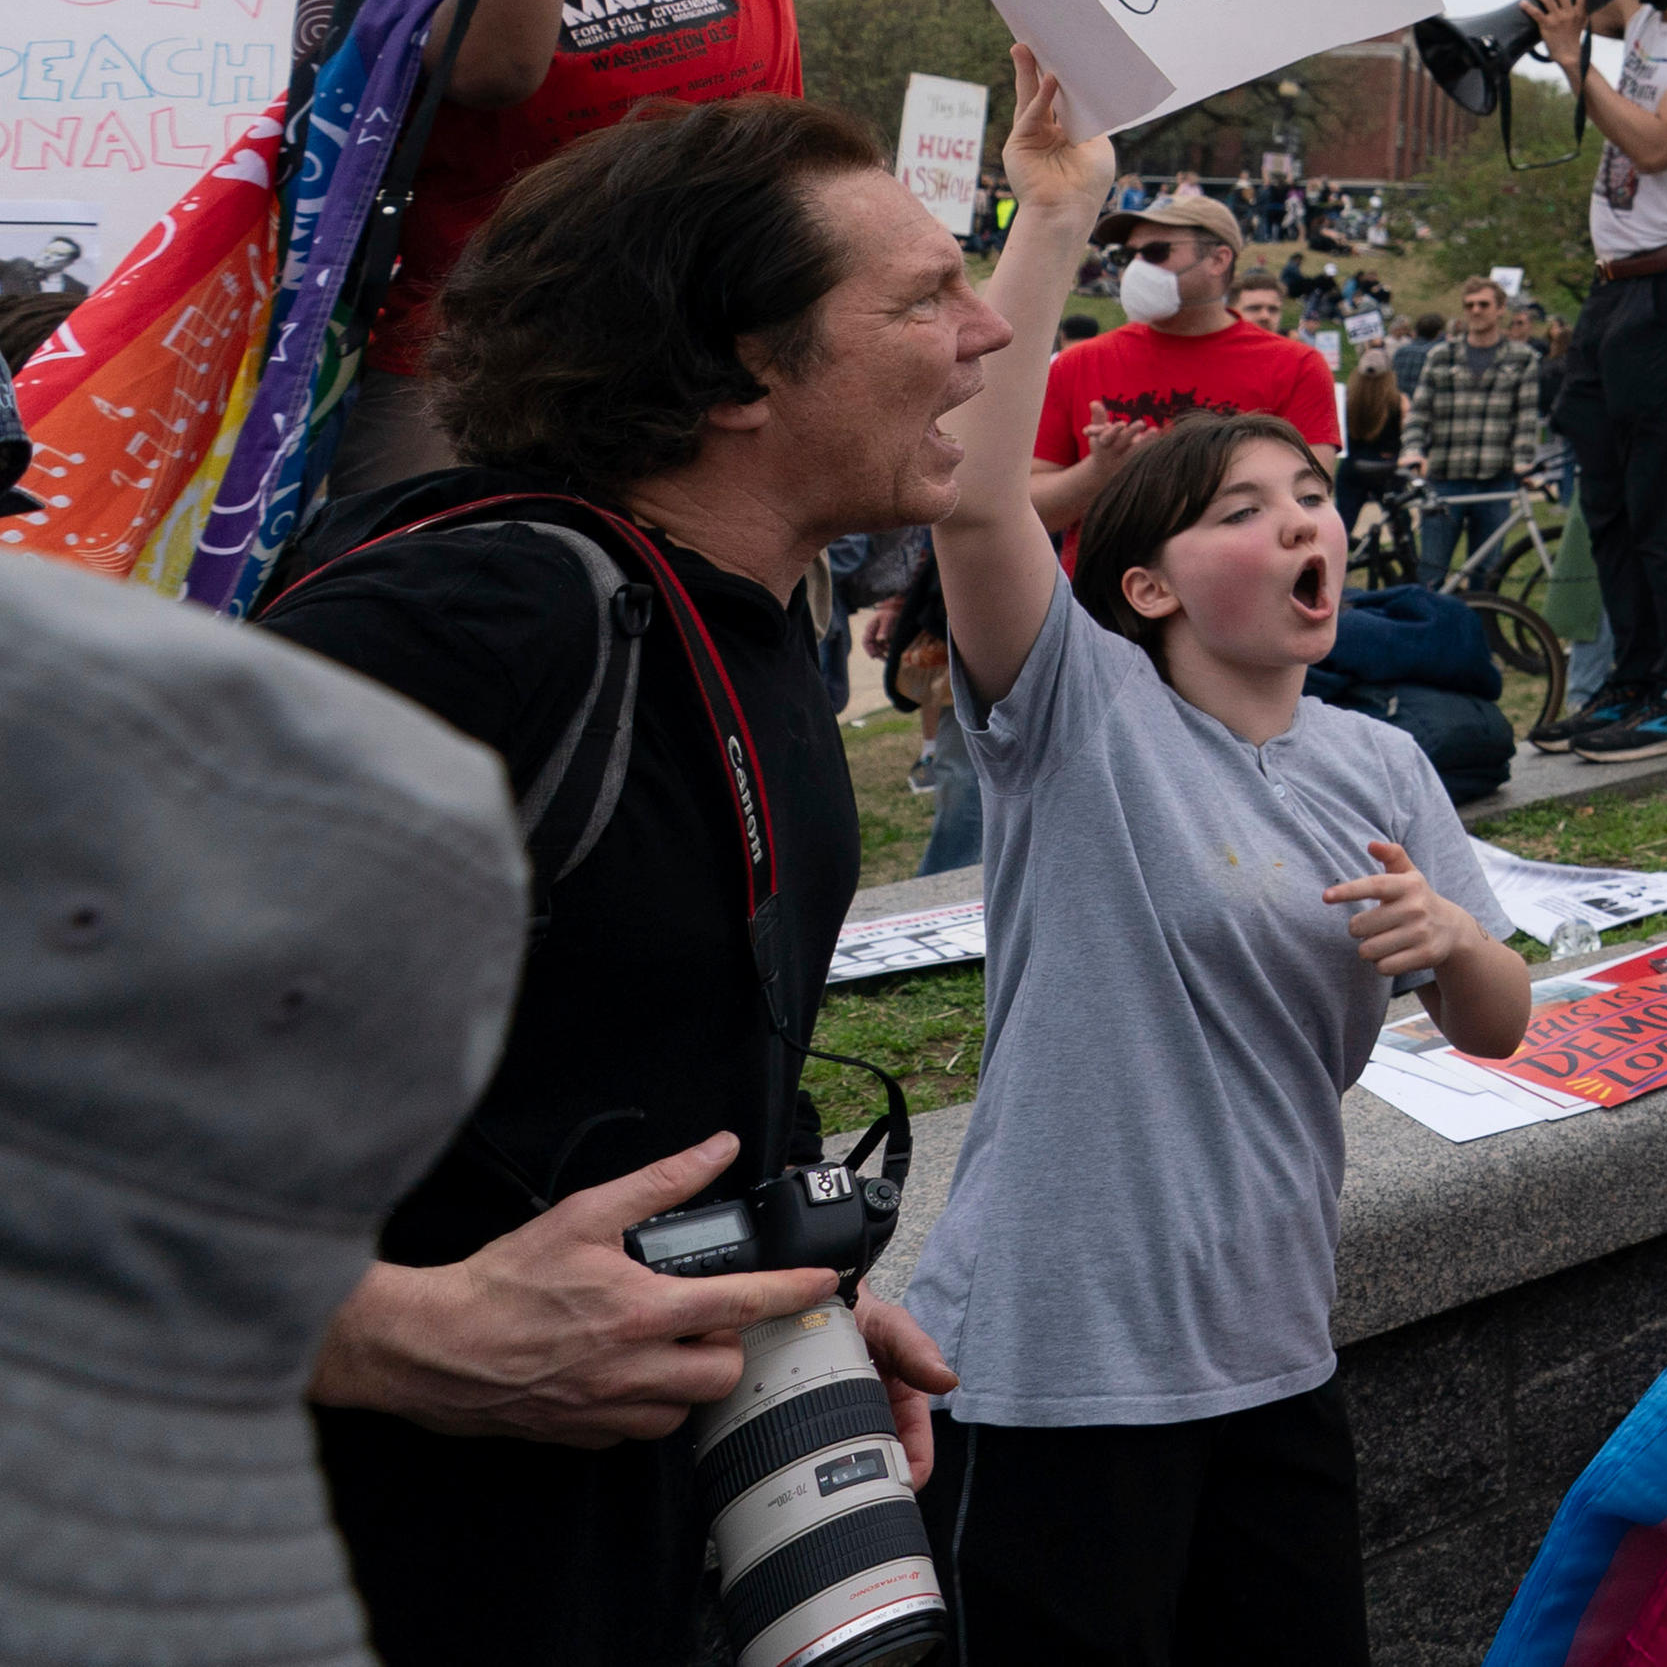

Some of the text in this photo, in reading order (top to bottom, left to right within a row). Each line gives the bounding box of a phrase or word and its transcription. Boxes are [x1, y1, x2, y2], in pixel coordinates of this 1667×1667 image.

[570, 23, 604, 41] FOR
[608, 11, 647, 32] FULL
[591, 33, 705, 72] WASHINGTON
[916, 134, 977, 162] HUGE
[728, 735, 763, 865] Canon
[1518, 1000, 1600, 1050] THIS
[1601, 988, 1640, 1010] IS
